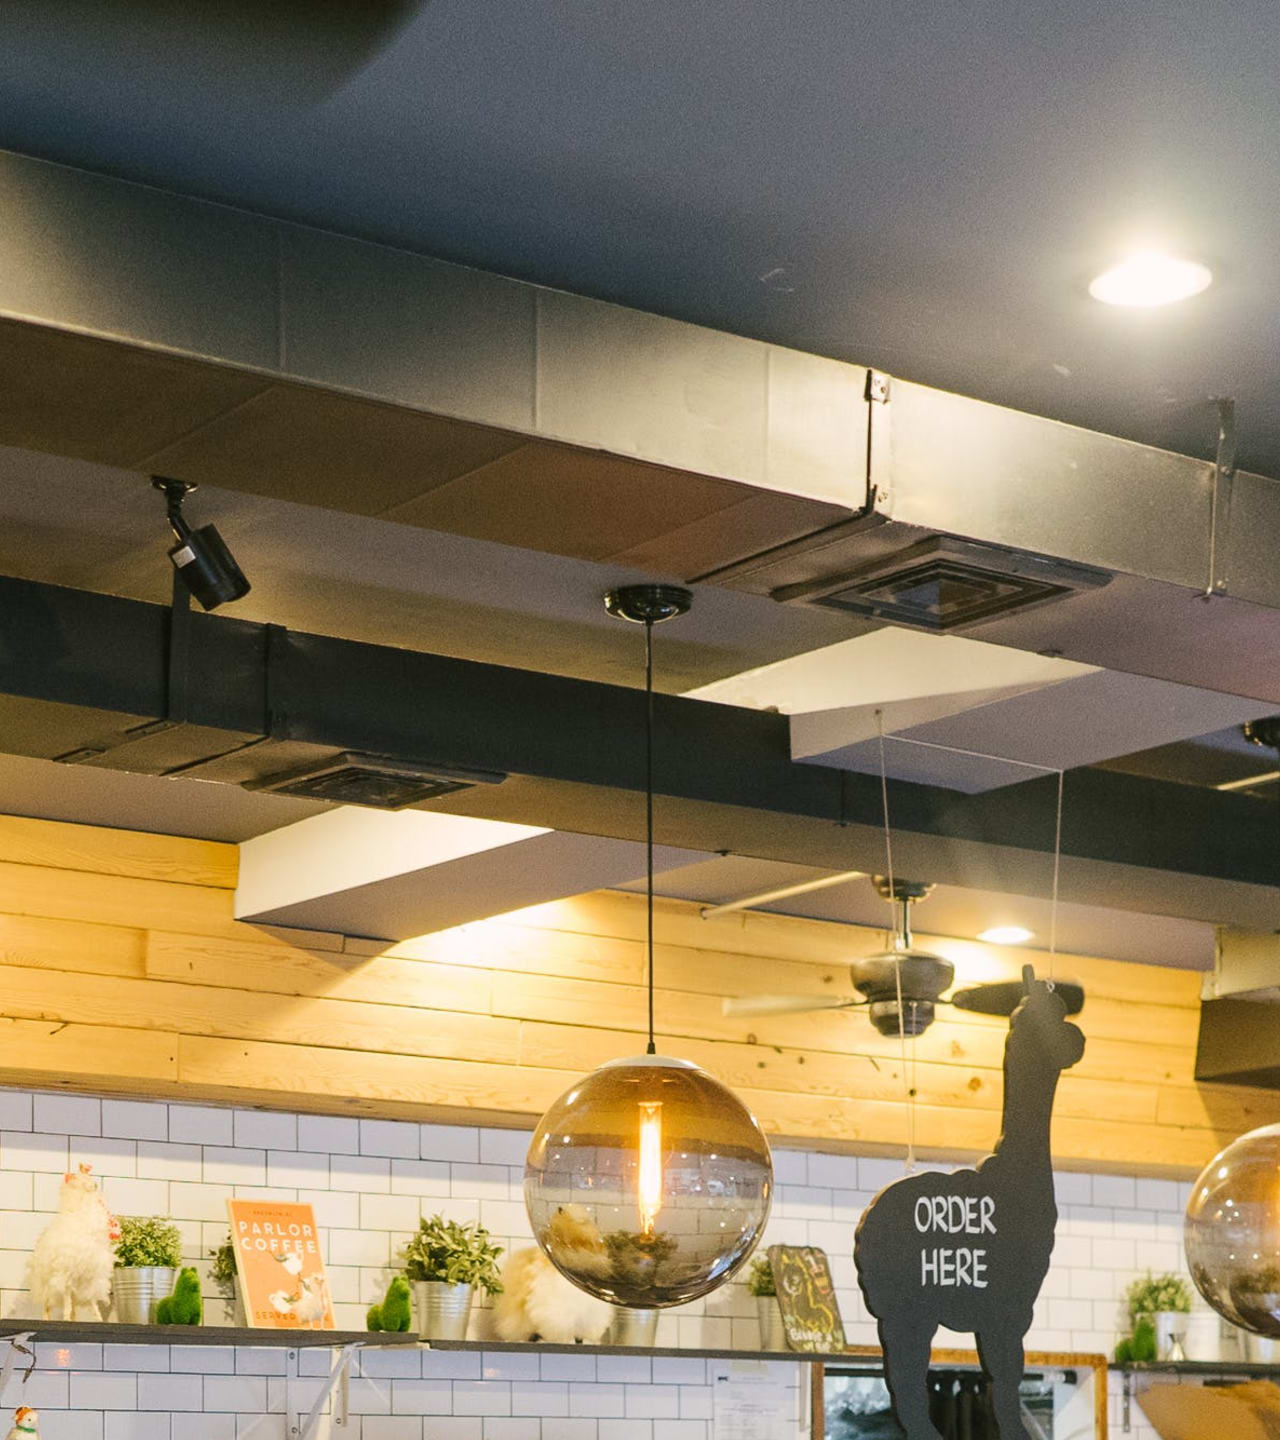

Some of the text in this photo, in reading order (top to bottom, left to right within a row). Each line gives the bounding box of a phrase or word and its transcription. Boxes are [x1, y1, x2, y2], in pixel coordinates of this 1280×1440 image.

[239, 1220, 313, 1237] PARLOR
[914, 1195, 998, 1234] ORDER
[241, 1237, 317, 1253] COFFEE
[921, 1247, 989, 1288] HERE
